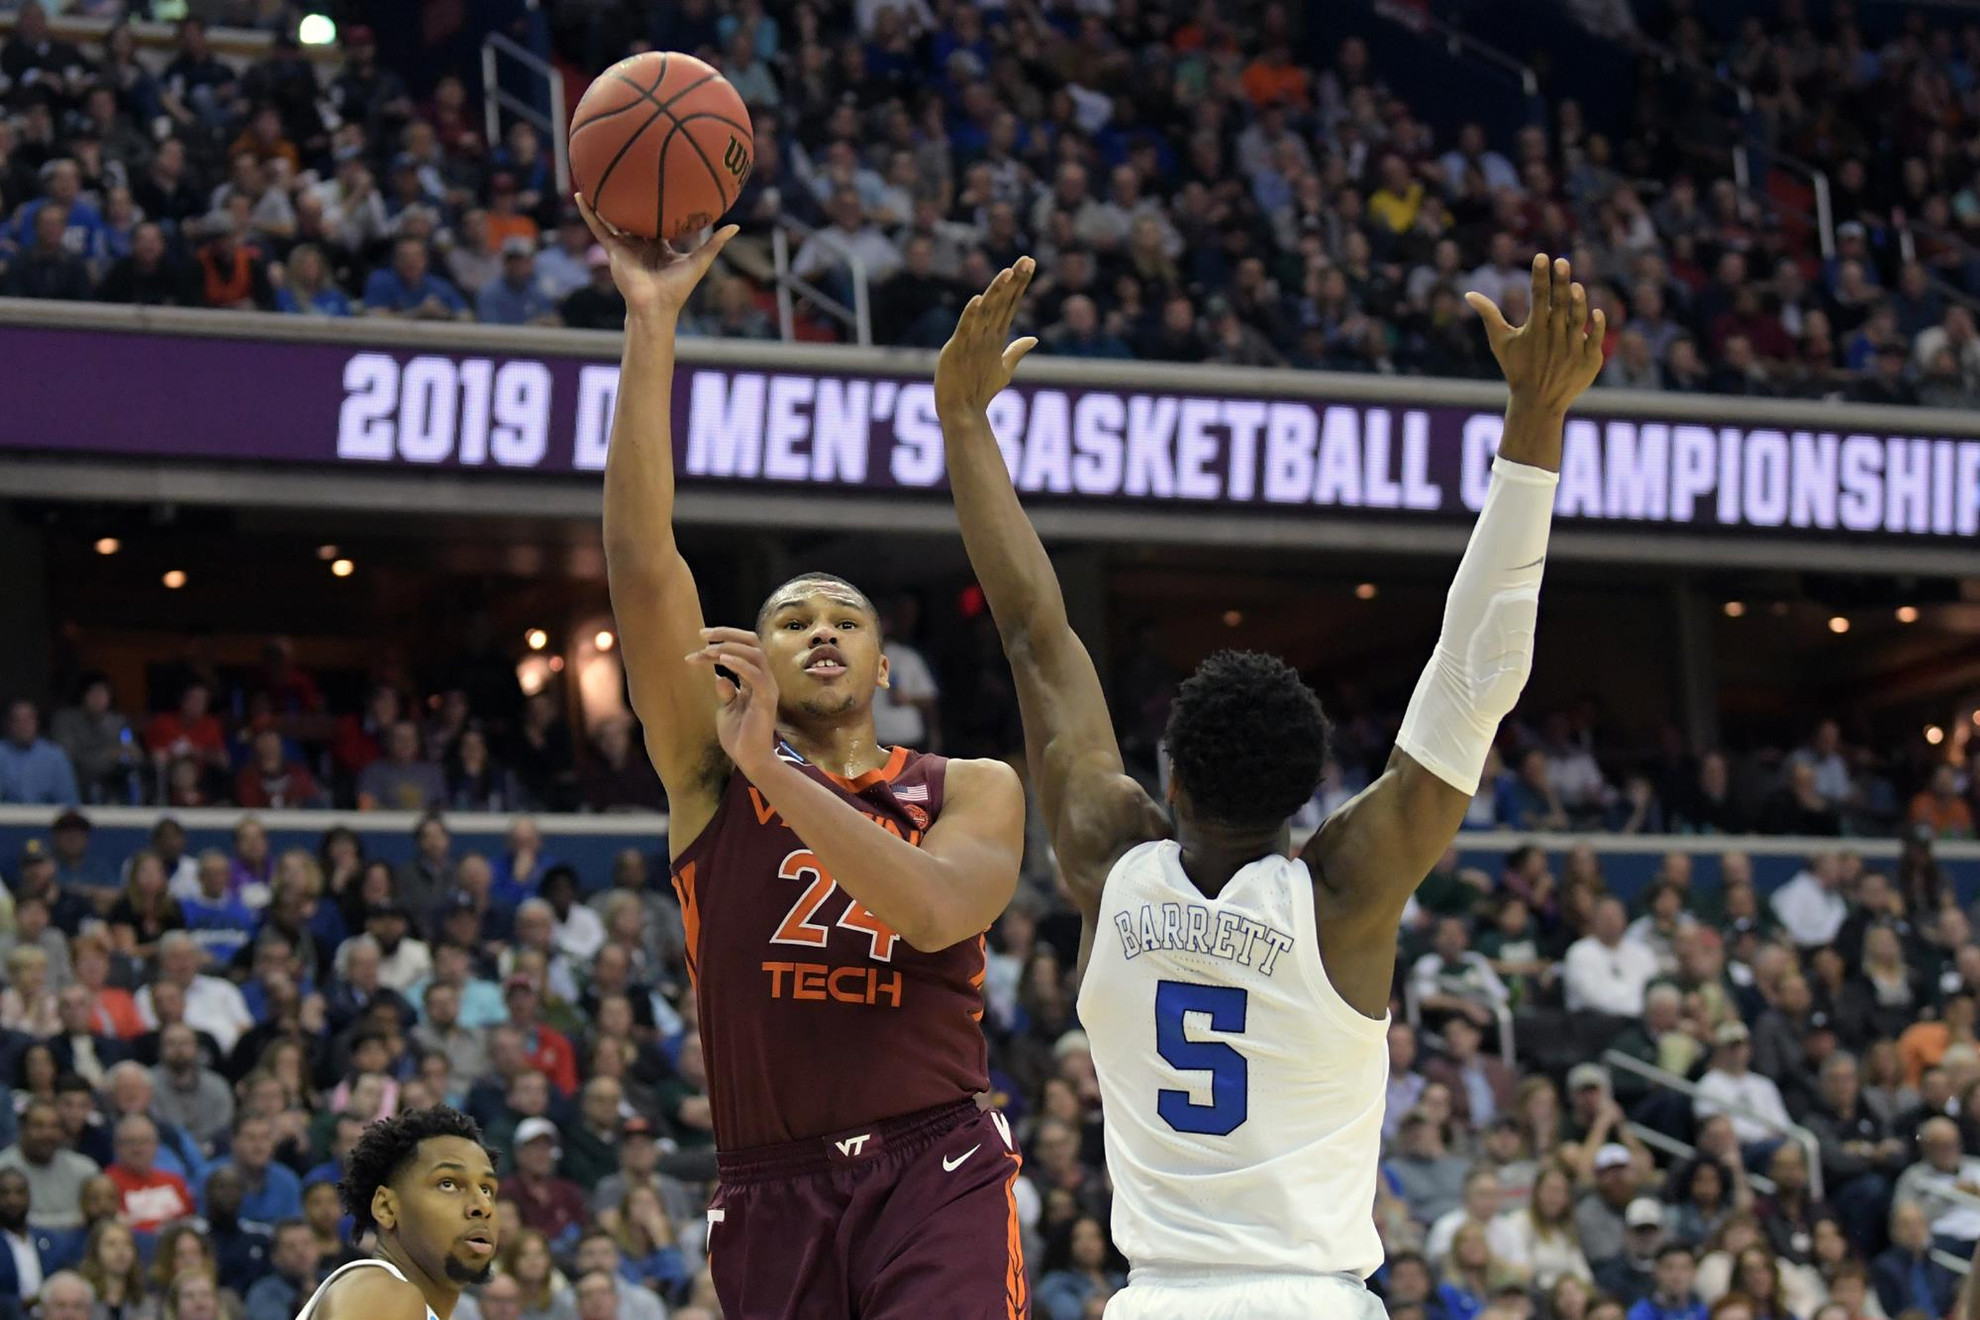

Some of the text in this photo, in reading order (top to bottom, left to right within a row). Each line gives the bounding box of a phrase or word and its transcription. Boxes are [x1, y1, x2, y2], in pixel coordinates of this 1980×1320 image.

[336, 352, 552, 467] 2019
[572, 364, 621, 472] D
[686, 371, 944, 487] MEN'S
[769, 849, 900, 962] 24
[1114, 902, 1294, 977] BARRETT
[761, 961, 902, 1008] TECH
[1155, 979, 1248, 1136] 5
[834, 1133, 871, 1157] VT
